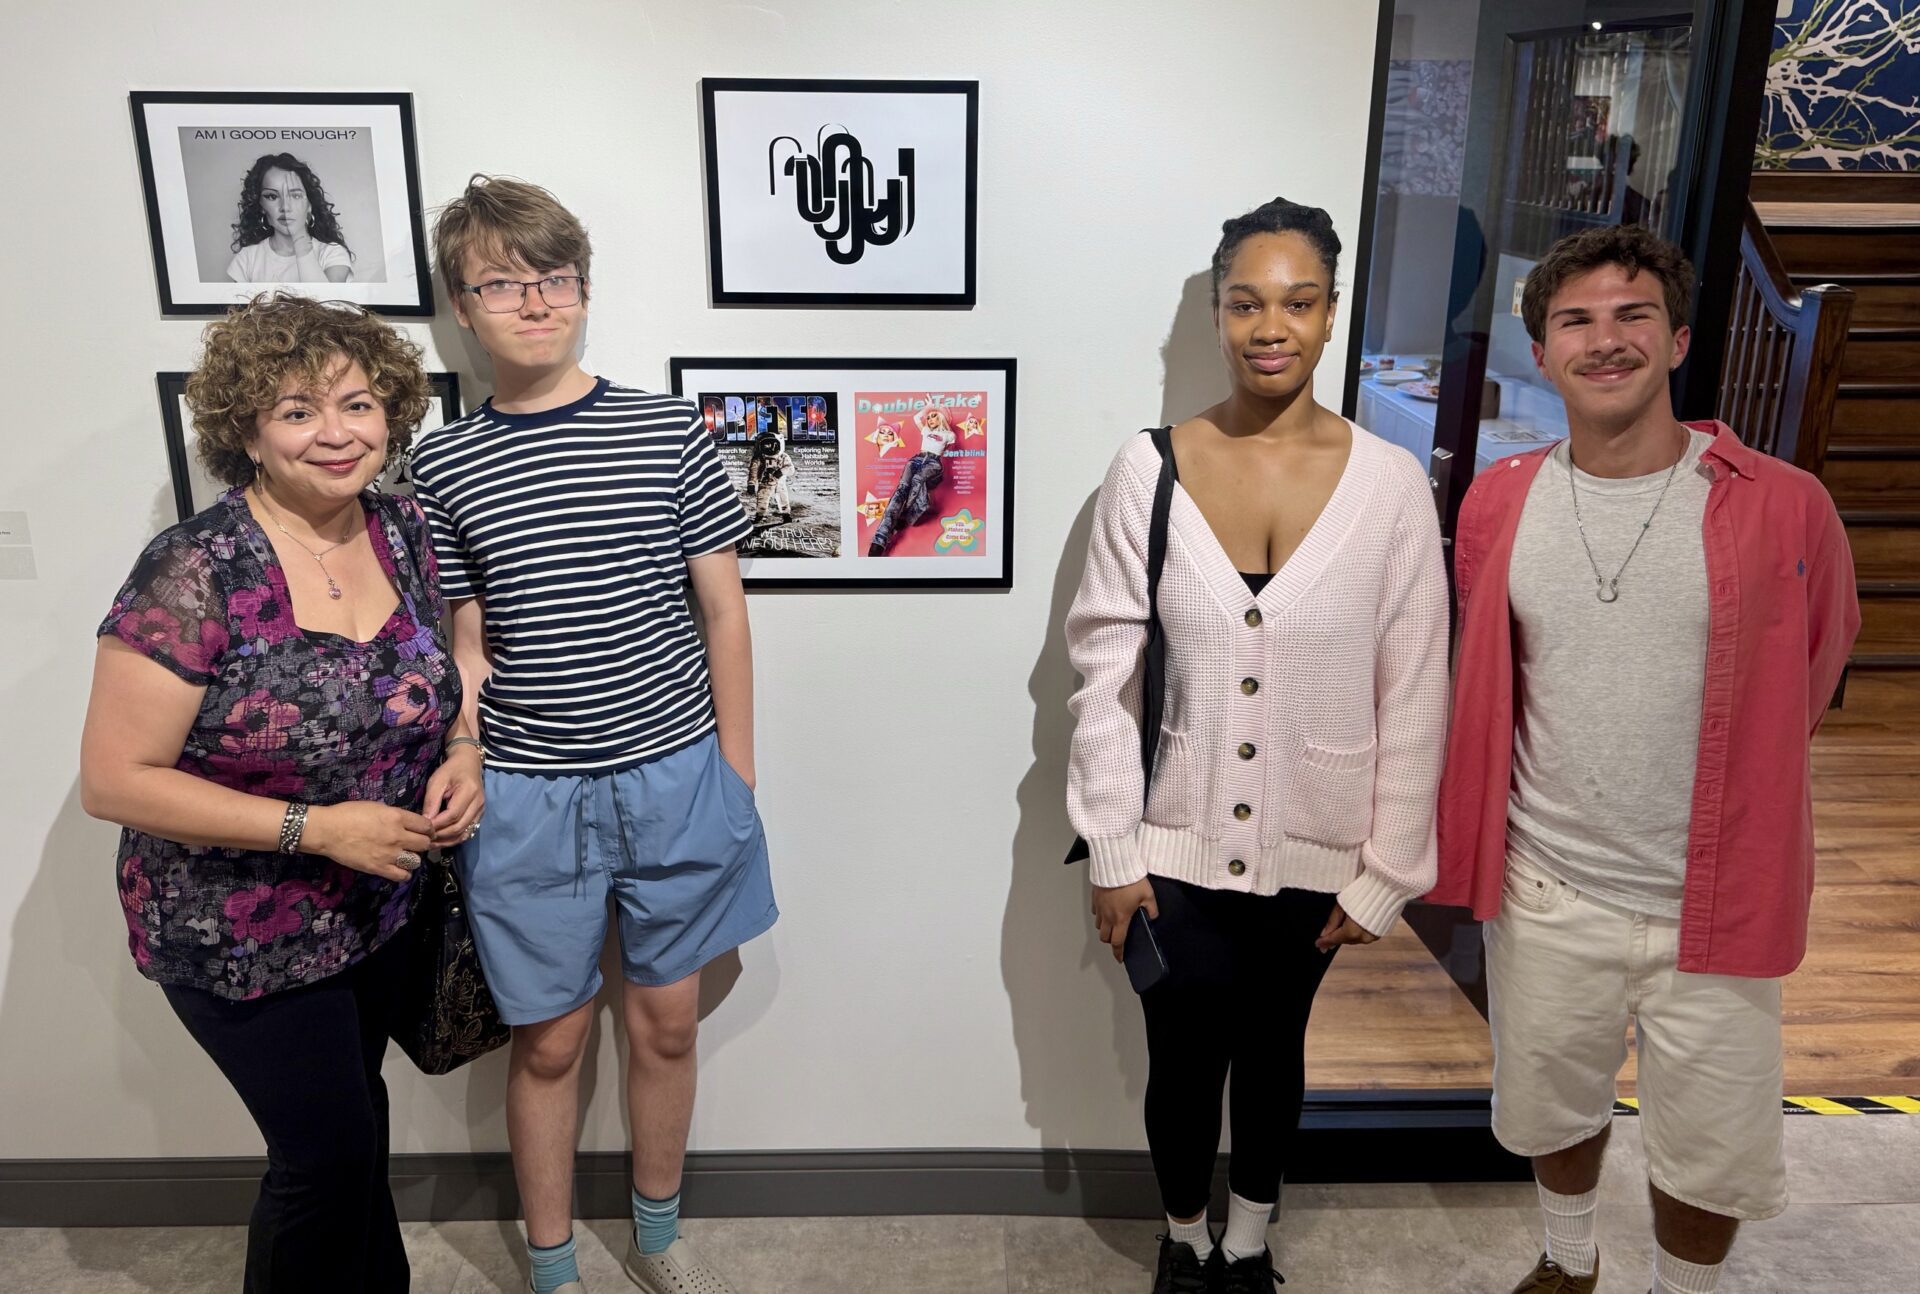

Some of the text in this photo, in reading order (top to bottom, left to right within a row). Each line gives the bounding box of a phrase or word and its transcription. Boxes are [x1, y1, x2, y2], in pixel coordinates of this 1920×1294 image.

[194, 129, 357, 140] AM I GOOD ENOUGH?
[858, 393, 981, 414] Double Take
[965, 449, 985, 457] blink
[760, 528, 814, 538] WE TRULY
[761, 538, 790, 551] OUT
[793, 538, 833, 550] HERE?
